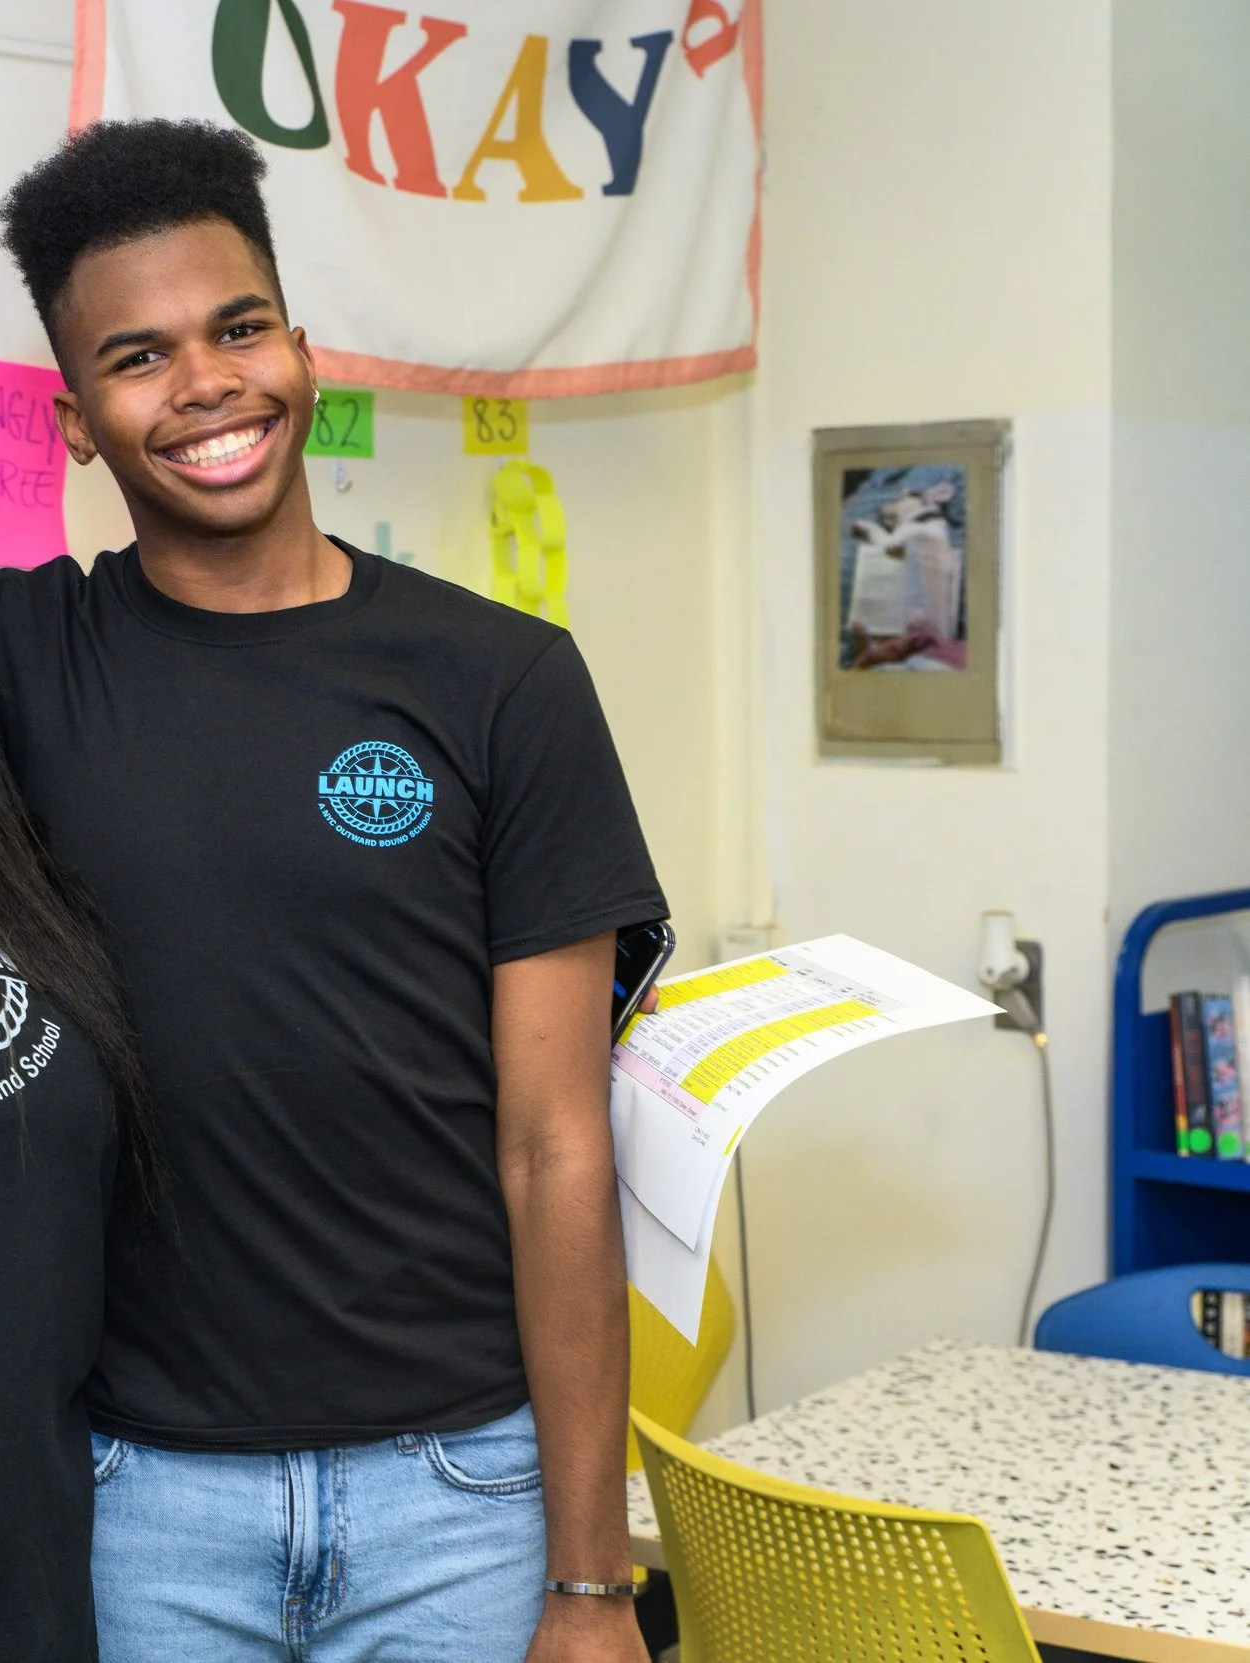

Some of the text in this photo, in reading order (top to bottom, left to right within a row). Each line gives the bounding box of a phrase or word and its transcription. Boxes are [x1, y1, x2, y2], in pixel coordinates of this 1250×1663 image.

[212, 0, 674, 203] OKAY
[315, 398, 360, 449] 82
[472, 397, 518, 444] 83
[318, 775, 434, 802] LAUNCH
[319, 810, 336, 827] NYC
[335, 825, 377, 847] OUTWARD
[379, 834, 409, 847] BOUND
[410, 811, 433, 838] SCHOOL
[19, 1018, 61, 1079] School
